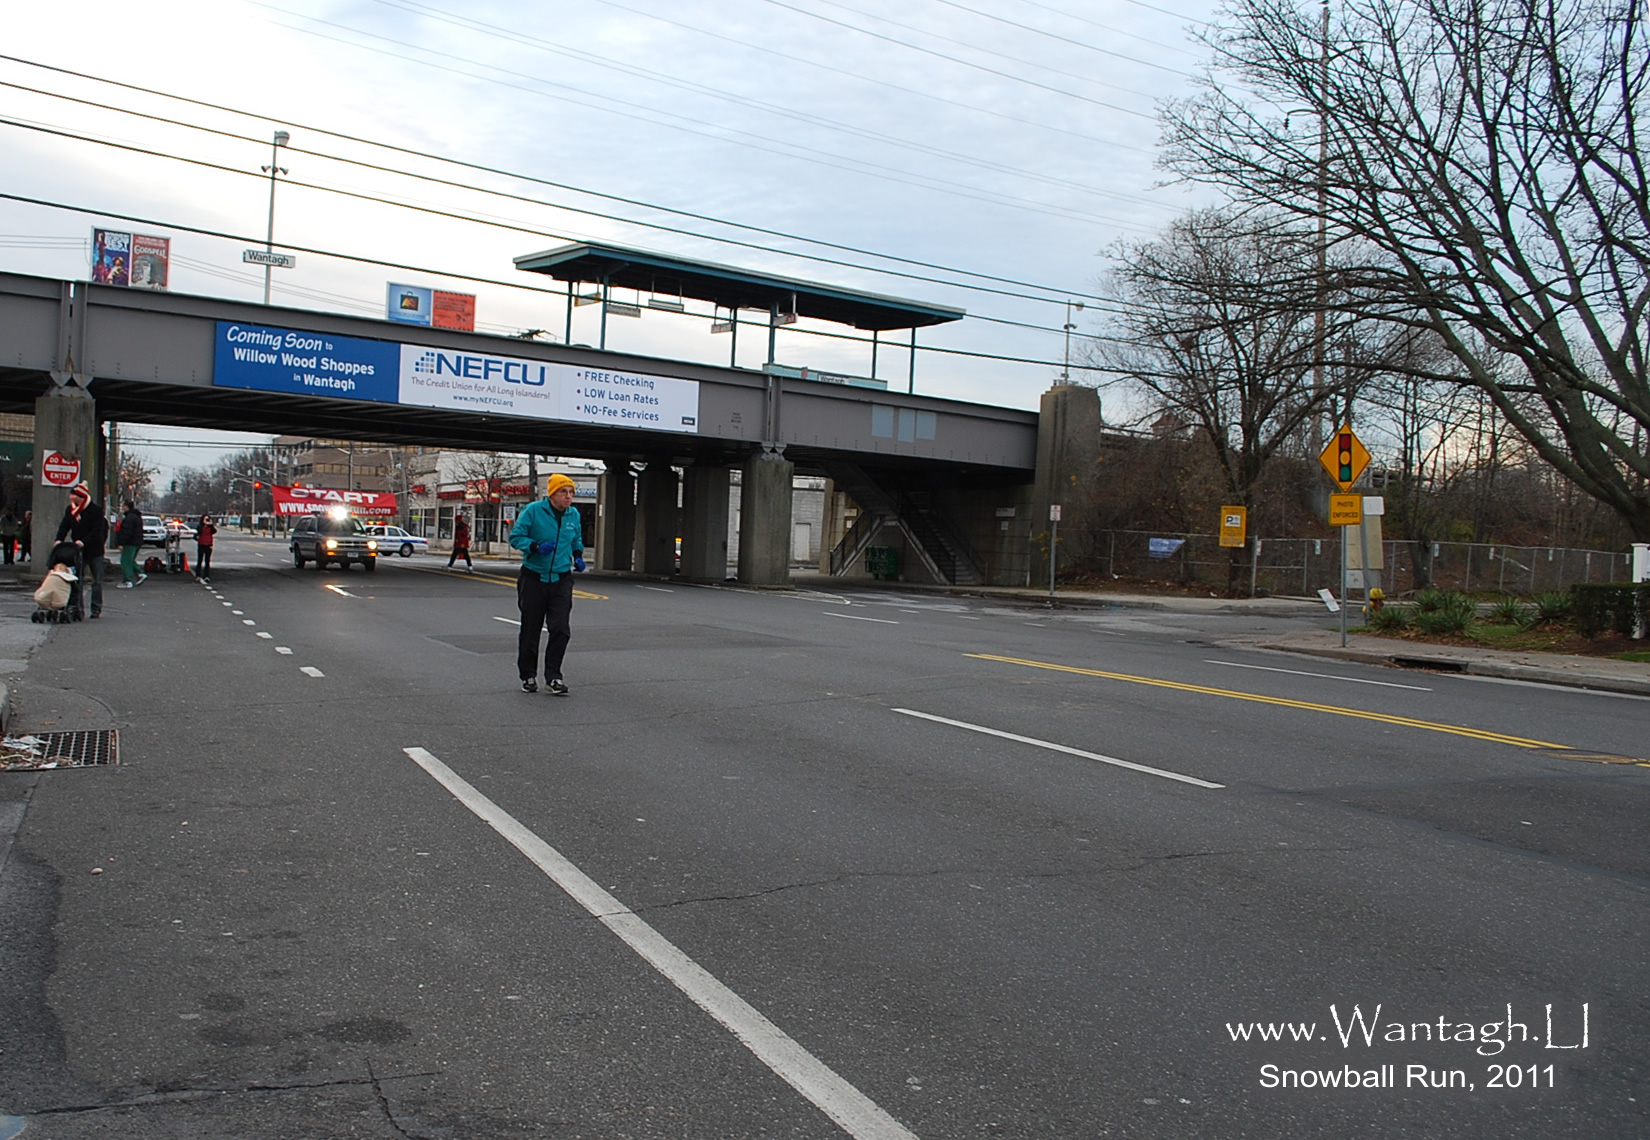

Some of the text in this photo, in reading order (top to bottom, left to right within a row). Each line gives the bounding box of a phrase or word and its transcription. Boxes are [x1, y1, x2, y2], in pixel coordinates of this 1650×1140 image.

[248, 250, 289, 266] Wantagh
[227, 326, 333, 351] Coming Soon to
[233, 347, 375, 375] Willow Wood Shoppes
[436, 352, 546, 387] NEFCU
[293, 373, 356, 392] in Wantagh
[411, 376, 551, 400] The Credit Union for All Long Islanders!
[584, 371, 655, 390] FREE Checking
[453, 395, 514, 408] www.myNEFCU.org
[584, 387, 659, 405] LOW Loan Rates
[583, 404, 660, 421] NO-Fee Services
[50, 456, 59, 464] DO
[50, 472, 72, 480] ENTER
[290, 488, 379, 504] START
